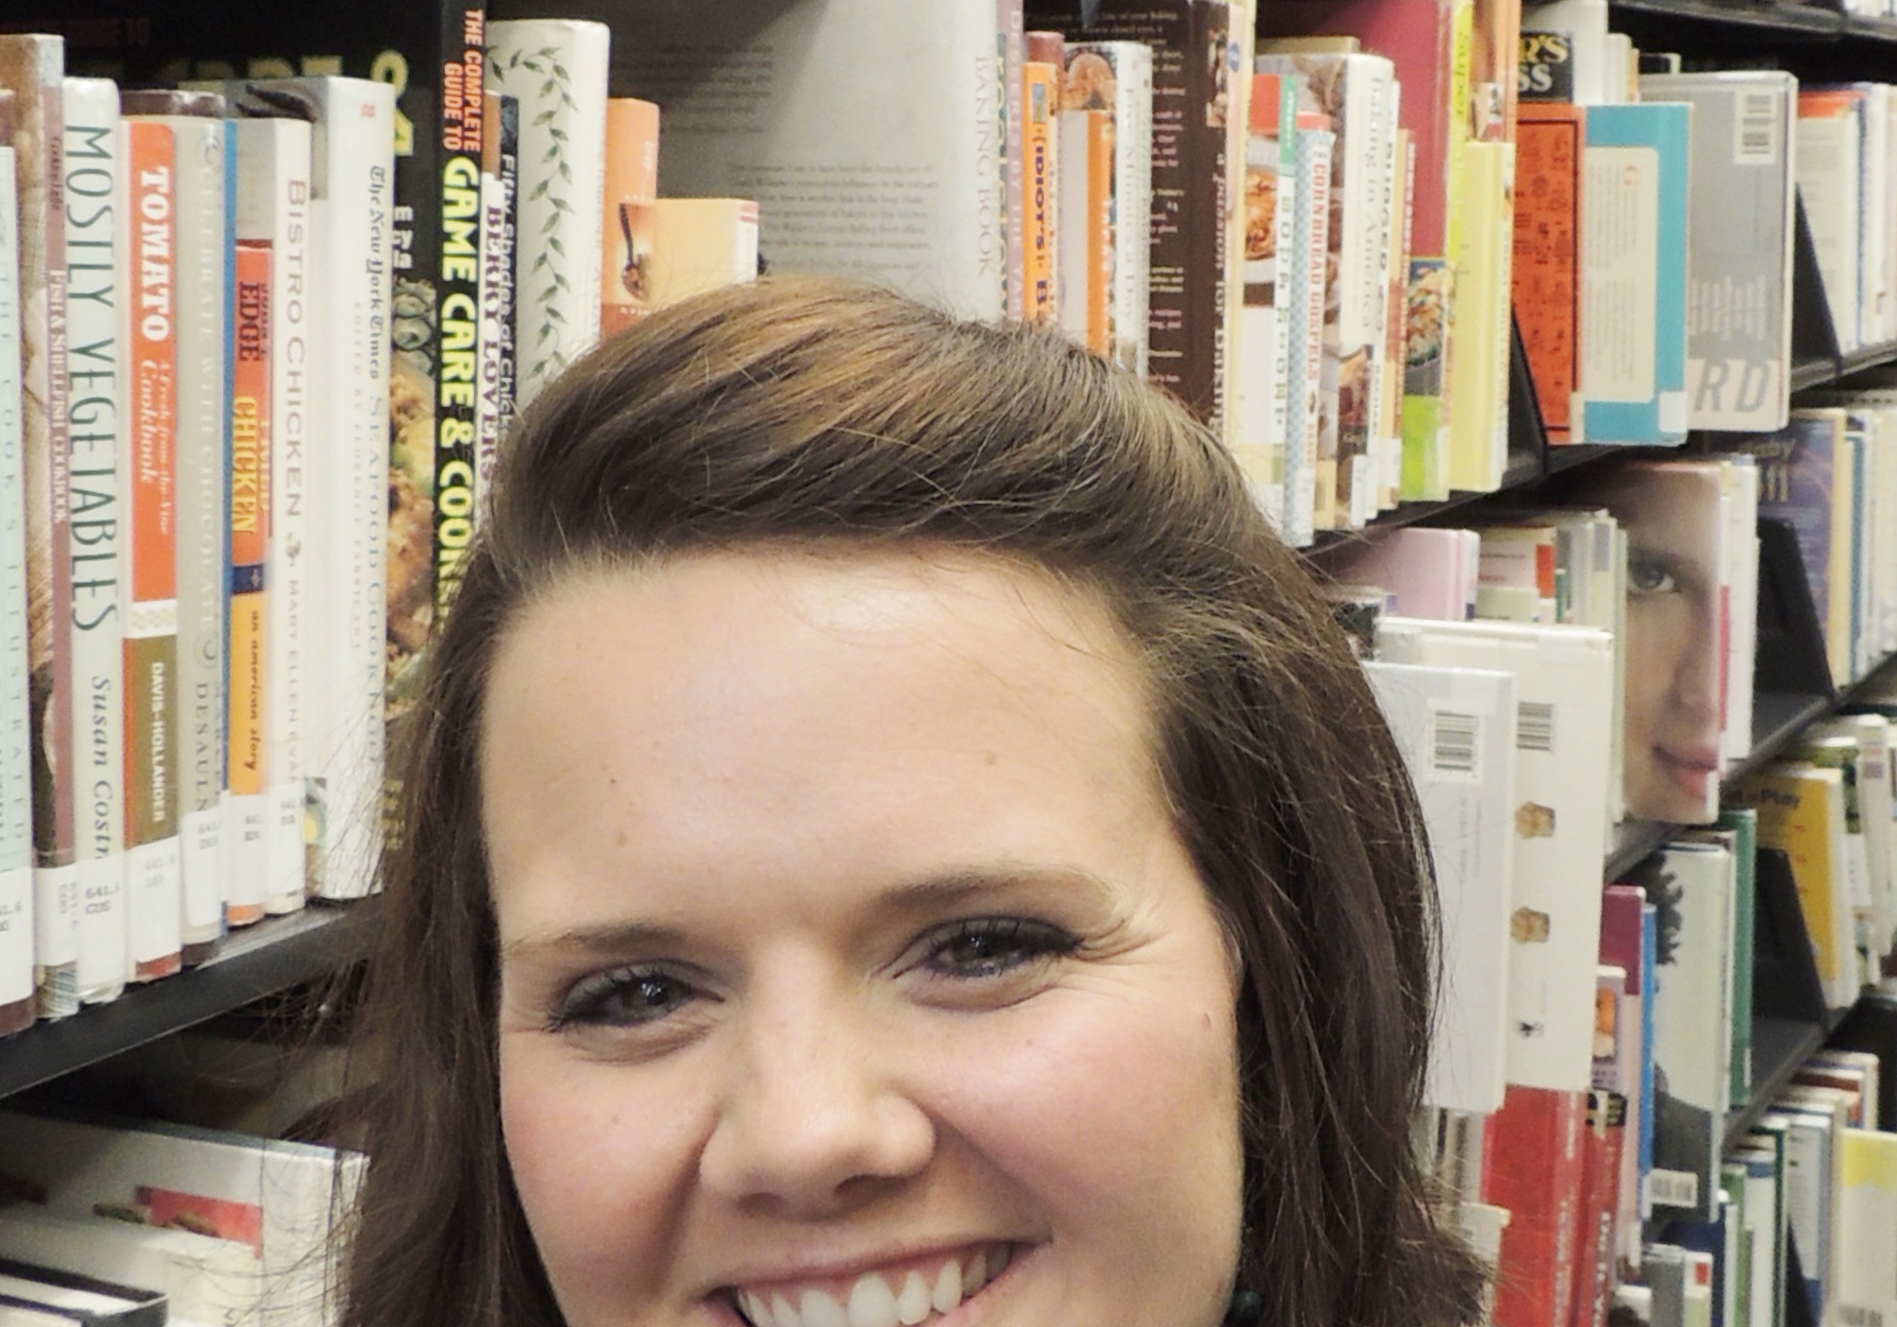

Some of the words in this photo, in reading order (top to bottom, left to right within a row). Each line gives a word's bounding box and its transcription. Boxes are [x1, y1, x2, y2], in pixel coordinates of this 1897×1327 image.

[465, 9, 484, 46] THE
[443, 62, 463, 120] GUIDE
[463, 49, 483, 153] COMPLETE
[975, 57, 994, 177] BAKING
[443, 125, 463, 151] TO
[1011, 159, 1021, 180] BY
[1216, 153, 1225, 166] a
[64, 125, 115, 308] MOSTLY
[368, 165, 386, 205] The
[442, 156, 479, 283] GAME
[501, 153, 516, 215] Fifty
[1012, 203, 1021, 243] THE
[1035, 146, 1045, 250] IDIOT'S
[1212, 171, 1226, 271] passion
[1310, 163, 1328, 285] CORNBREAD
[140, 165, 171, 342] TOMATO
[198, 165, 216, 343] CELEBRATE
[286, 178, 306, 325] BISTRO
[369, 207, 384, 254] New
[484, 205, 502, 321] BERRY
[500, 222, 515, 318] Shades
[977, 187, 994, 278] BOOK
[48, 269, 65, 310] FISH
[49, 314, 65, 329] &
[238, 280, 261, 362] EDGE
[366, 258, 384, 311] York
[1214, 280, 1227, 316] for
[49, 332, 66, 427] SHELLFISH
[369, 314, 384, 380] Times
[440, 292, 477, 408] CARE
[500, 323, 514, 350] of
[1306, 291, 1324, 381] GOSPELS
[139, 359, 159, 484] Cookbook
[199, 355, 216, 434] WITH
[285, 336, 306, 518] CHICKEN
[439, 418, 475, 448] &
[51, 435, 67, 523] COOKBOOK
[66, 338, 118, 632] VEGETABLES
[232, 395, 258, 534] CHICKEN
[367, 395, 384, 569] SEAFOOD
[199, 446, 216, 632] CHOCOLATE
[250, 610, 261, 633] an
[288, 579, 299, 641] MARY
[92, 675, 113, 767] Susan
[249, 639, 262, 721] american
[287, 650, 299, 724] ELLEN
[150, 661, 166, 823] DAVIS-HOLLANDER
[244, 727, 262, 772] story
